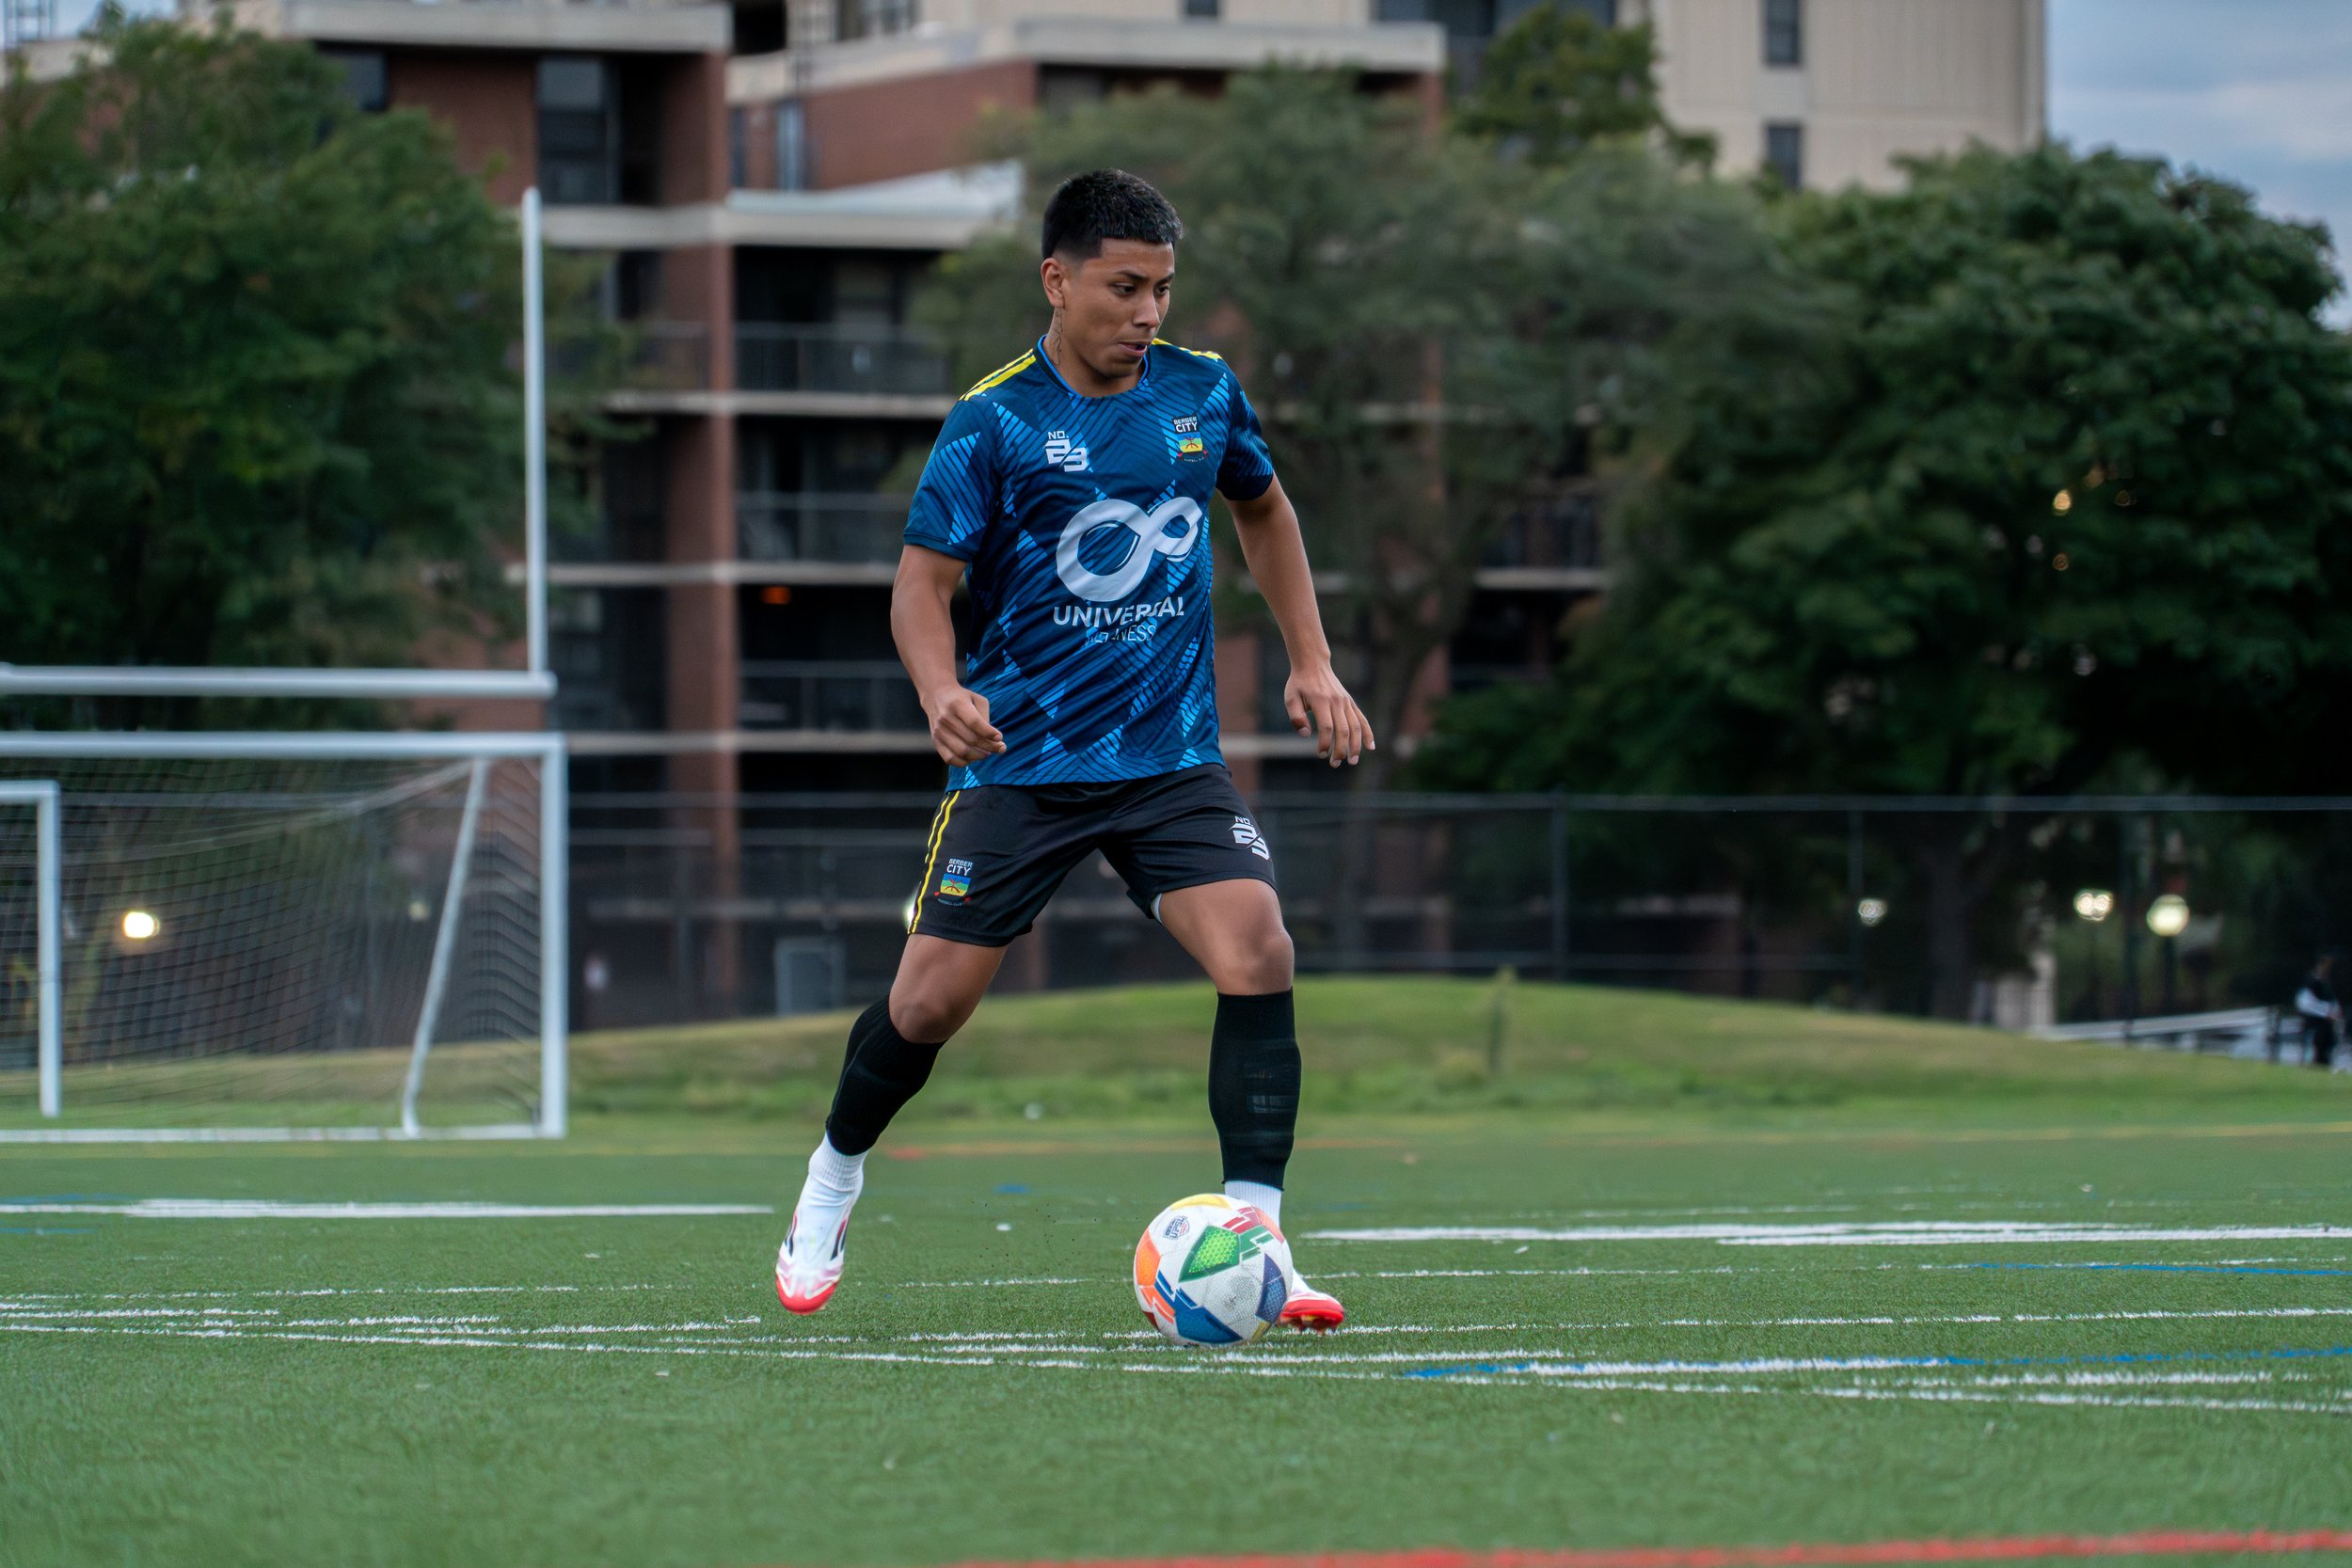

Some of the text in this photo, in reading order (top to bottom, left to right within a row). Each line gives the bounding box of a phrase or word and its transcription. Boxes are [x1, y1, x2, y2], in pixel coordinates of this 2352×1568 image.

[1173, 416, 1198, 425] BERBER
[1175, 421, 1198, 434] CITY
[1047, 430, 1070, 439] NO.
[1042, 438, 1088, 472] 23
[1053, 596, 1185, 627] UNIVERSAL
[948, 858, 974, 868] BERBER
[946, 863, 972, 877] CITY
[1169, 1217, 1185, 1239] UPSL
